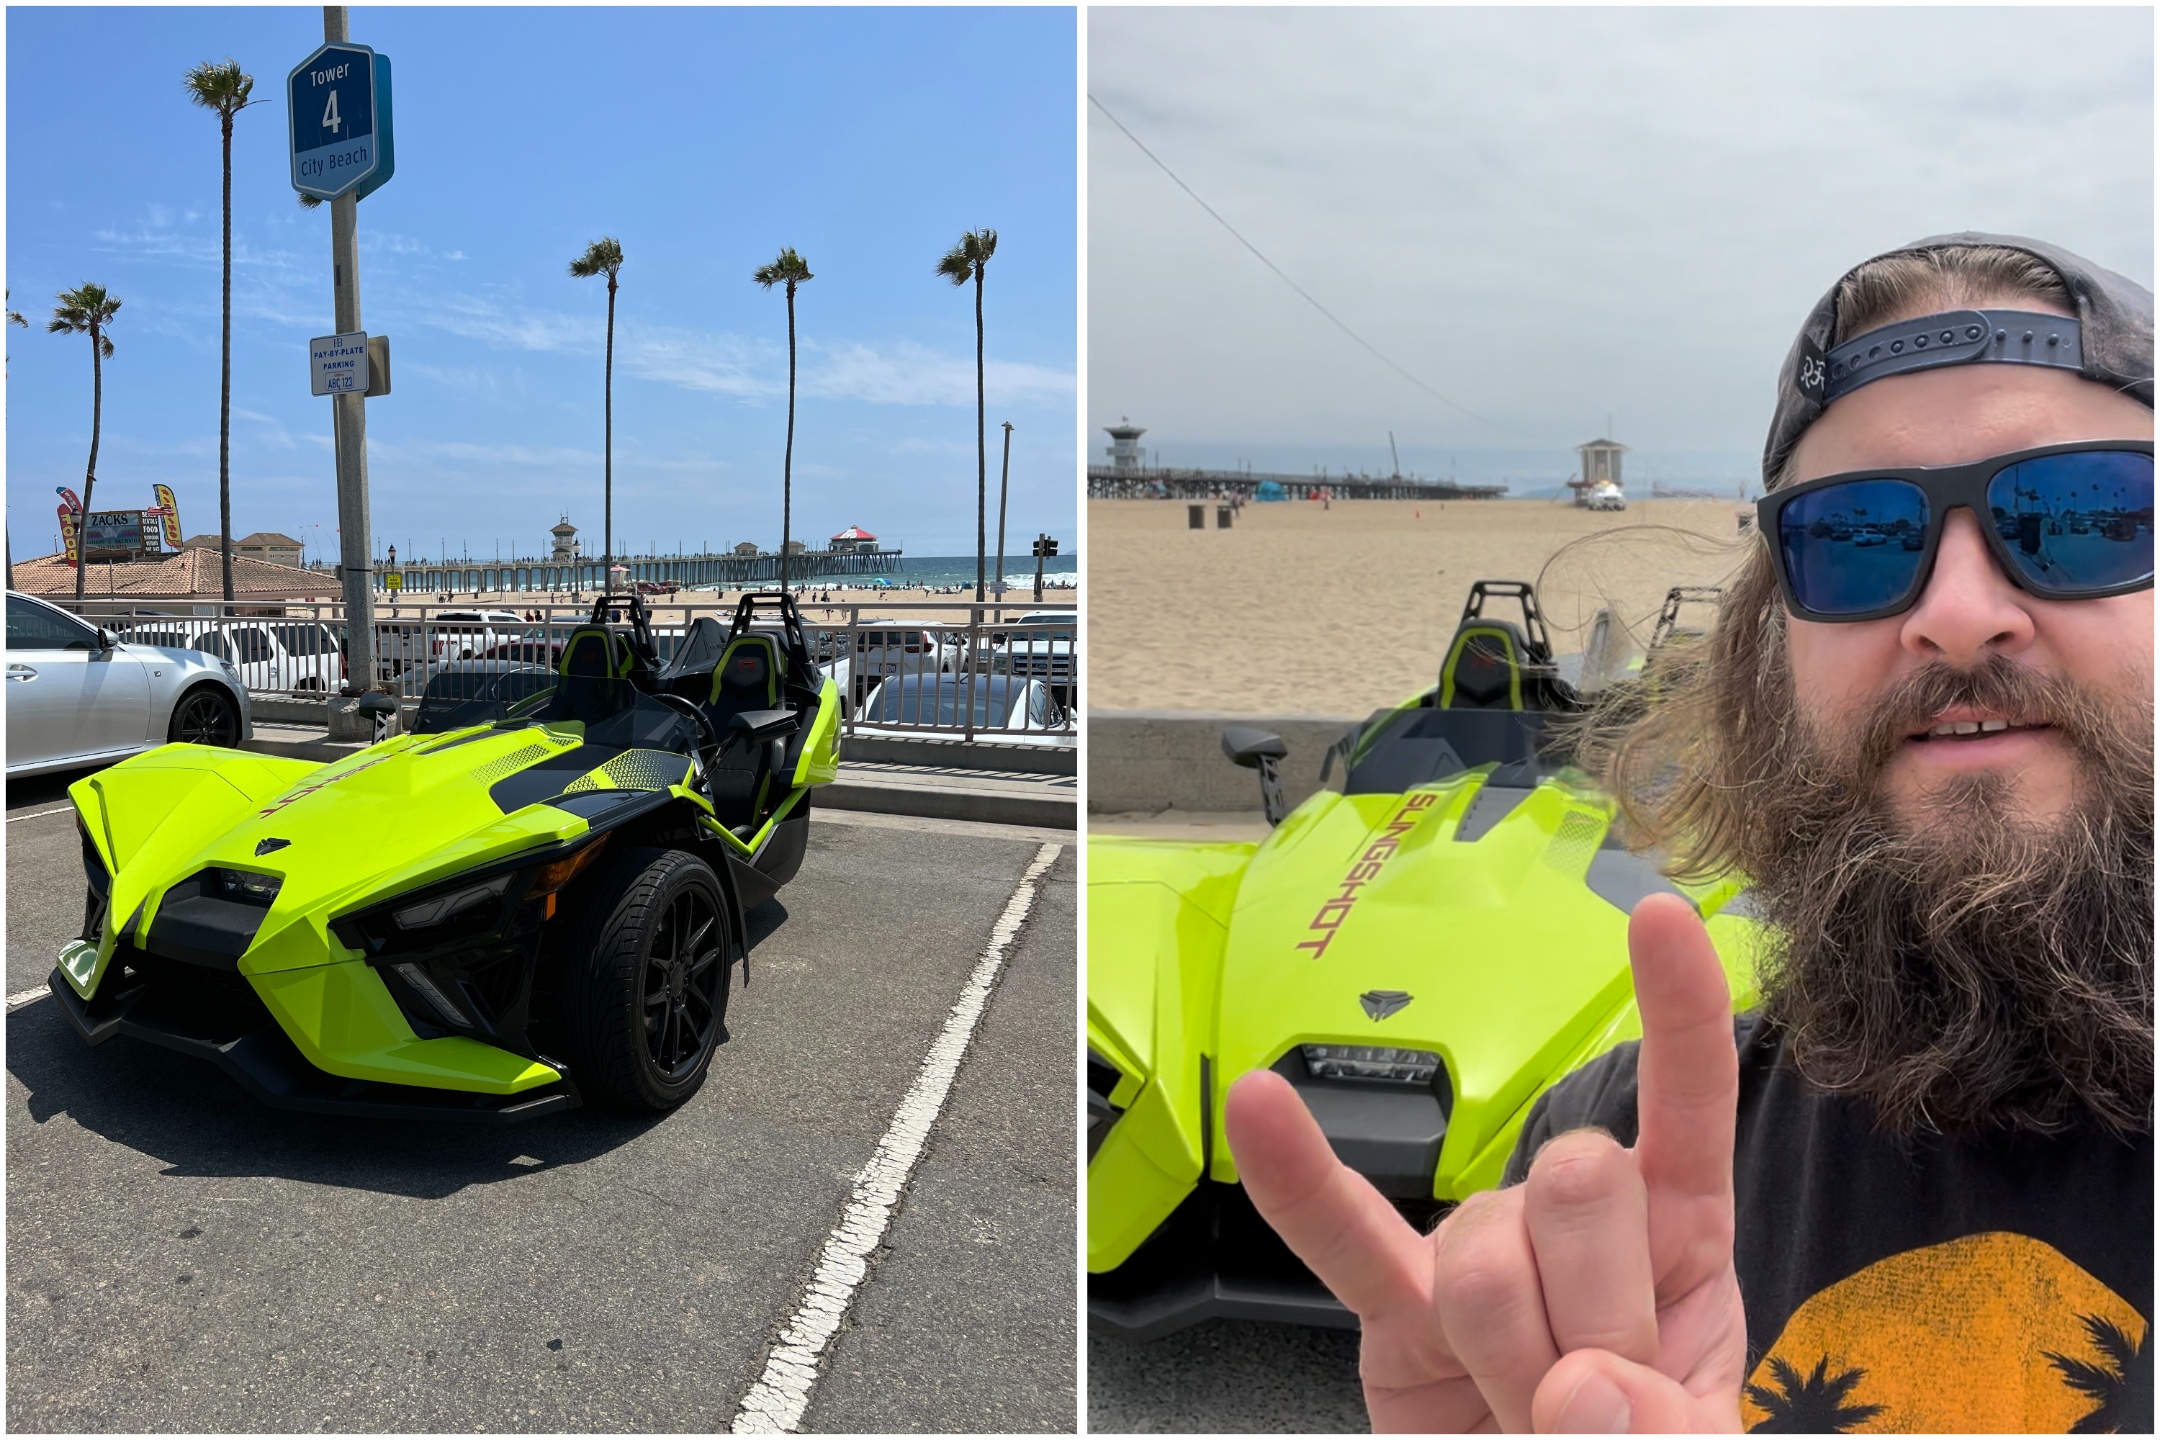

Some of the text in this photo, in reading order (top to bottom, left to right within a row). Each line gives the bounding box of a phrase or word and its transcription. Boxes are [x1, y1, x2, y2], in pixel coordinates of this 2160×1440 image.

[310, 62, 350, 87] Tower
[322, 89, 342, 134] 4
[301, 145, 367, 177] City Beach
[314, 346, 364, 359] PAY-BY-PLATE
[323, 360, 355, 370] PARKING
[328, 376, 352, 388] ABC 123
[91, 514, 128, 526] ZACKS
[1295, 793, 1438, 961] SLINGSHOT
